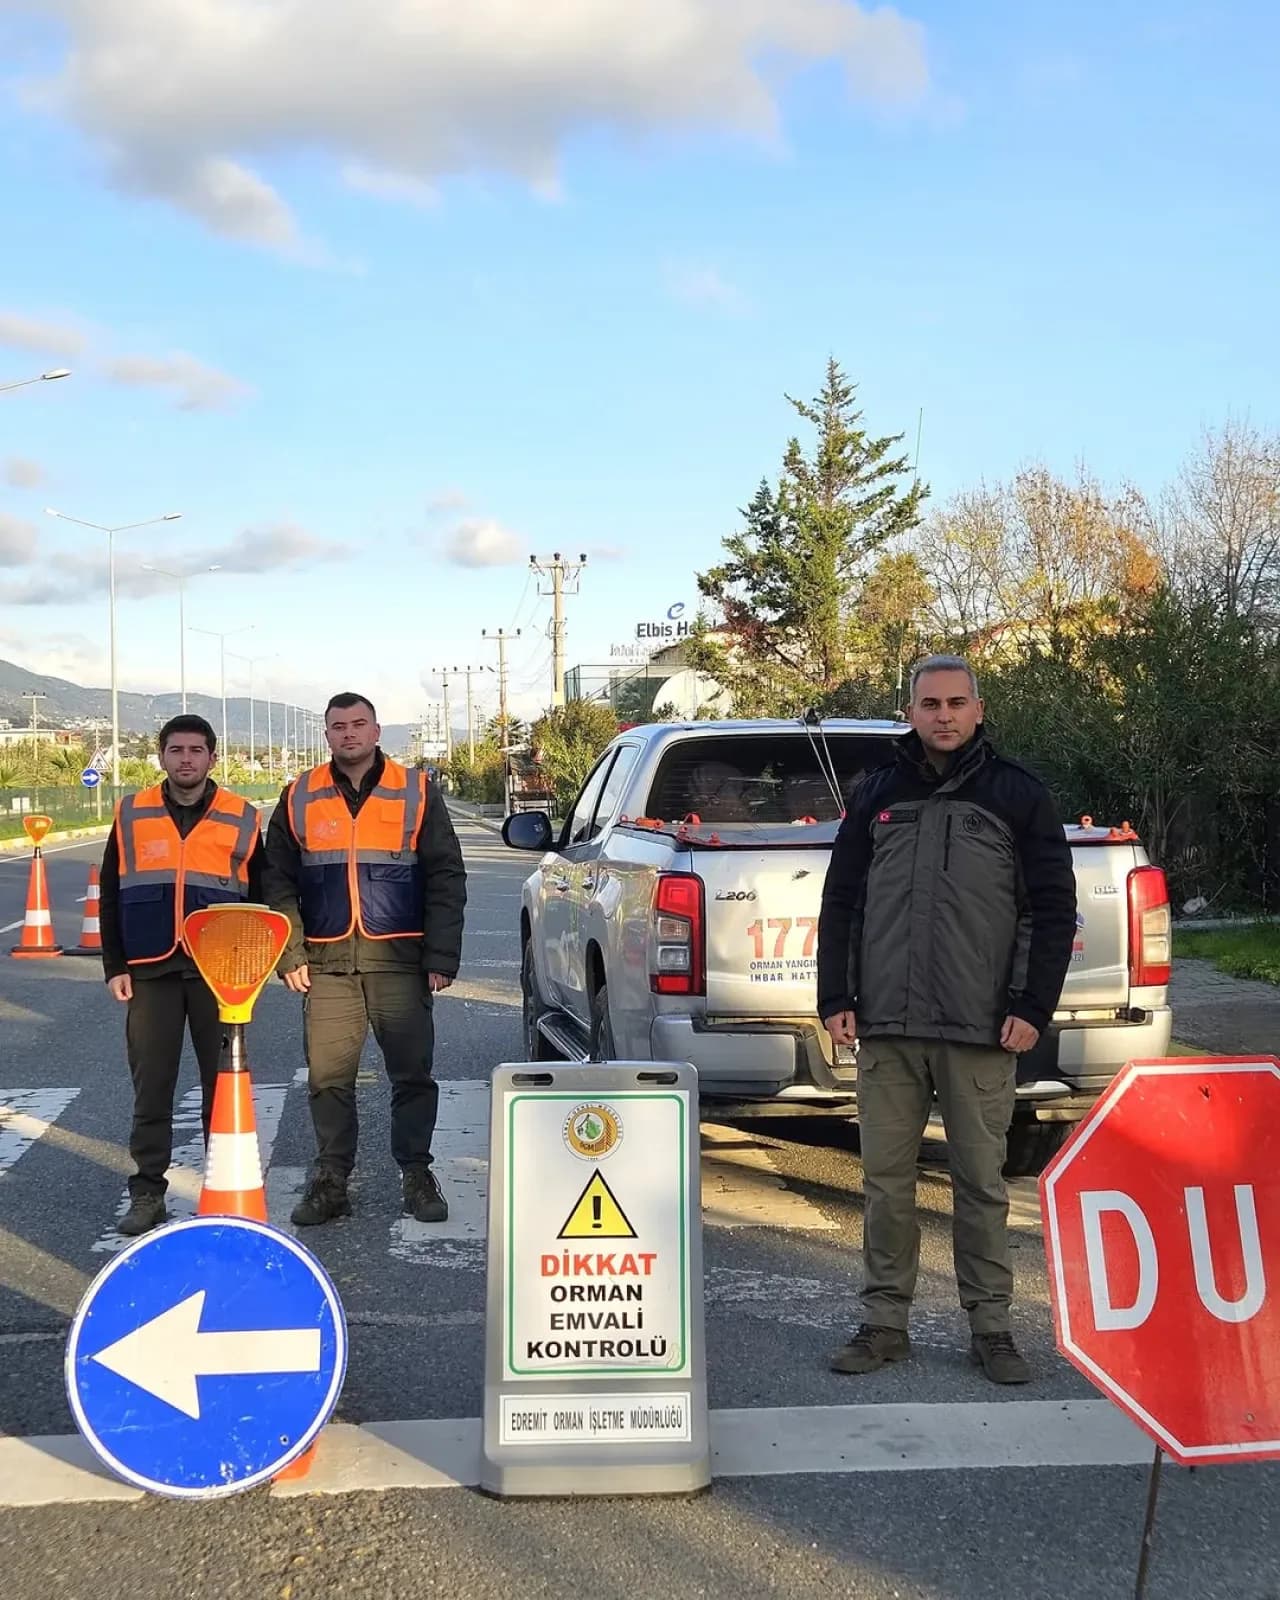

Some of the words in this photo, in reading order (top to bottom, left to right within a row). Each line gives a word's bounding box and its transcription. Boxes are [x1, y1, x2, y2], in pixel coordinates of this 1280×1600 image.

[637, 622, 673, 637] Elbis
[715, 889, 757, 901] L200
[747, 917, 818, 959] 177
[750, 961, 783, 970] ORMAN
[791, 971, 818, 980] HATT
[541, 1249, 657, 1276] DİKKAT
[1080, 1184, 1266, 1331] DU
[550, 1284, 642, 1302] ORMAN
[550, 1307, 643, 1330] EMVALİ
[527, 1335, 667, 1358] KONTROLÜ
[511, 1408, 547, 1431] EDREMİT
[553, 1410, 583, 1430] ORMAN
[589, 1405, 624, 1435] İŞLETME
[630, 1405, 682, 1429] MÜDÜRLÜĞÜ
